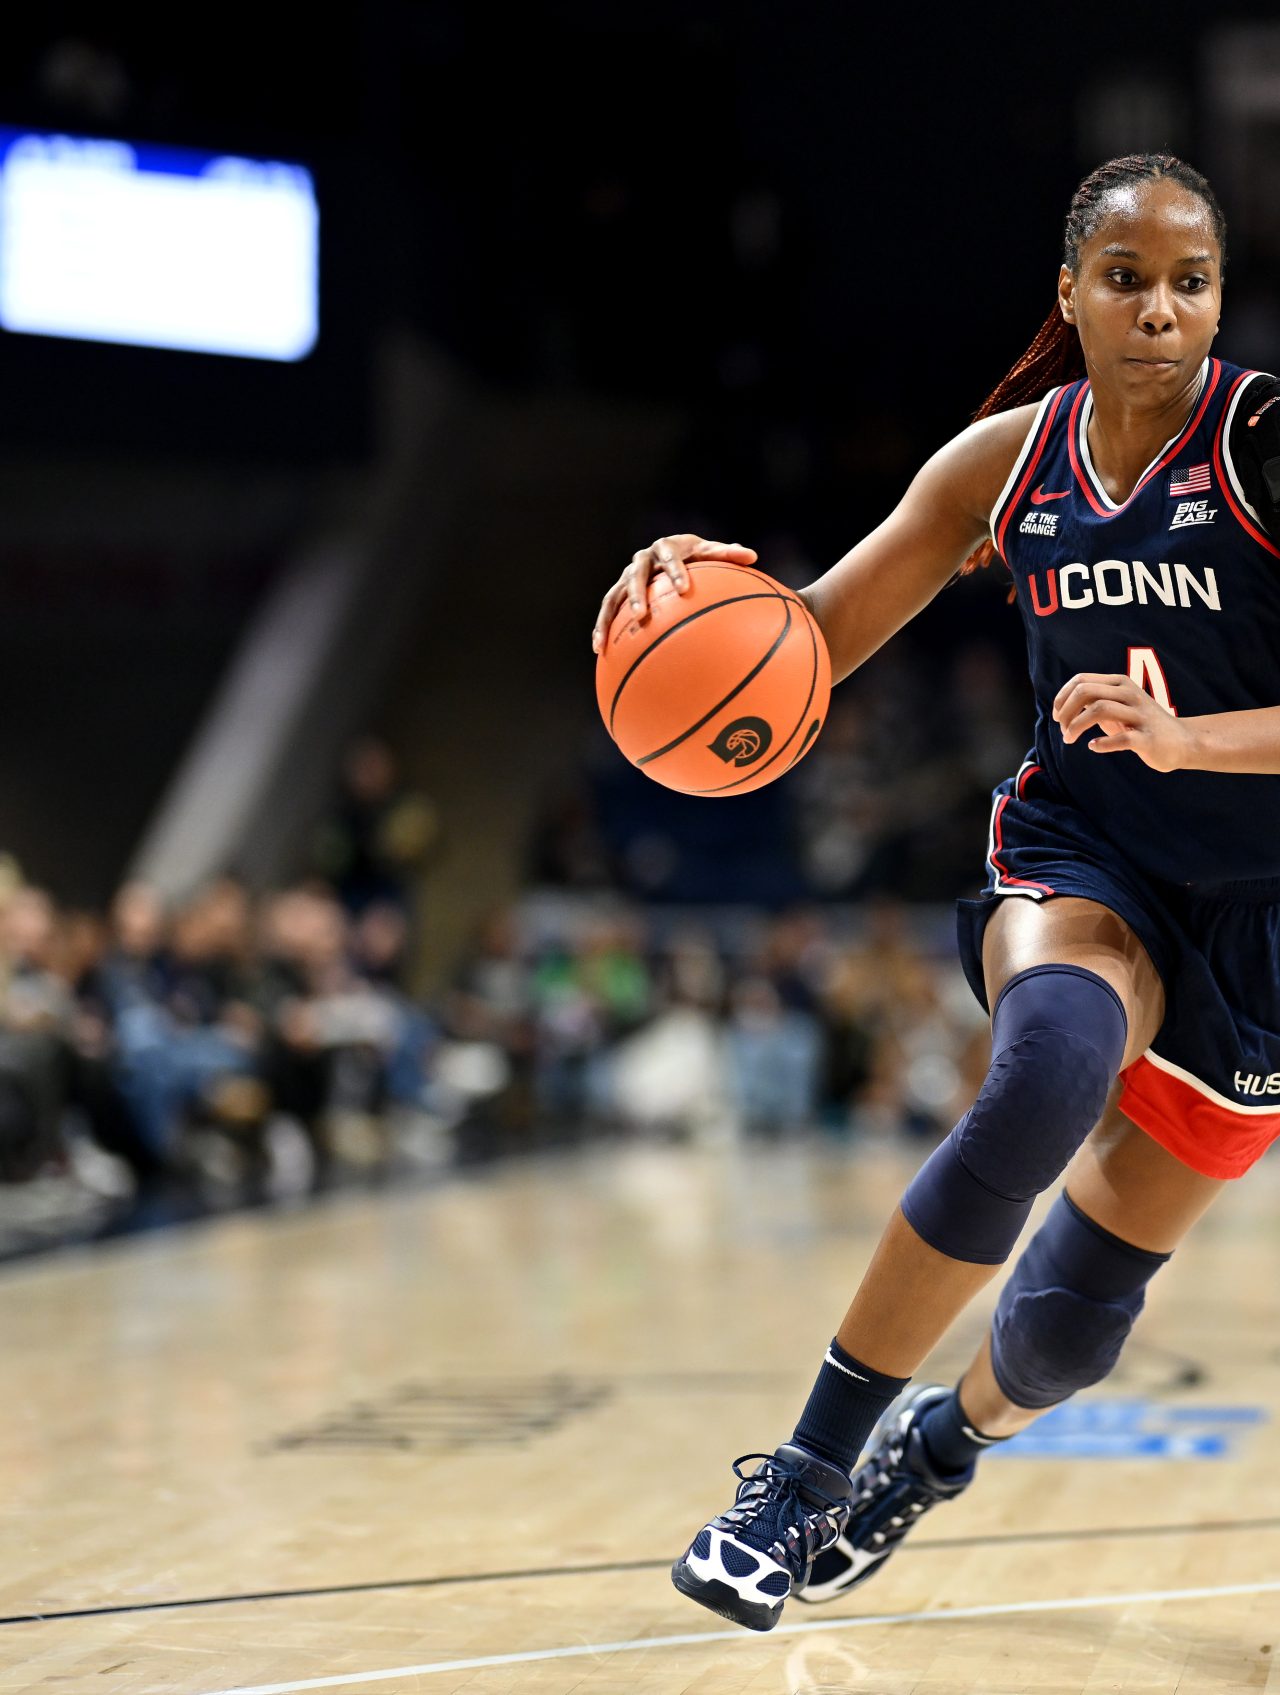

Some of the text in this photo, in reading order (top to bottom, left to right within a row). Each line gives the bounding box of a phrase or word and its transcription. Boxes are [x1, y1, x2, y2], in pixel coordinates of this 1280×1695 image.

[1175, 500, 1209, 514] BIG
[1024, 512, 1060, 526] BE THE
[1171, 509, 1218, 525] EAST
[1019, 522, 1058, 537] CHANGE
[1028, 559, 1222, 617] UCONN
